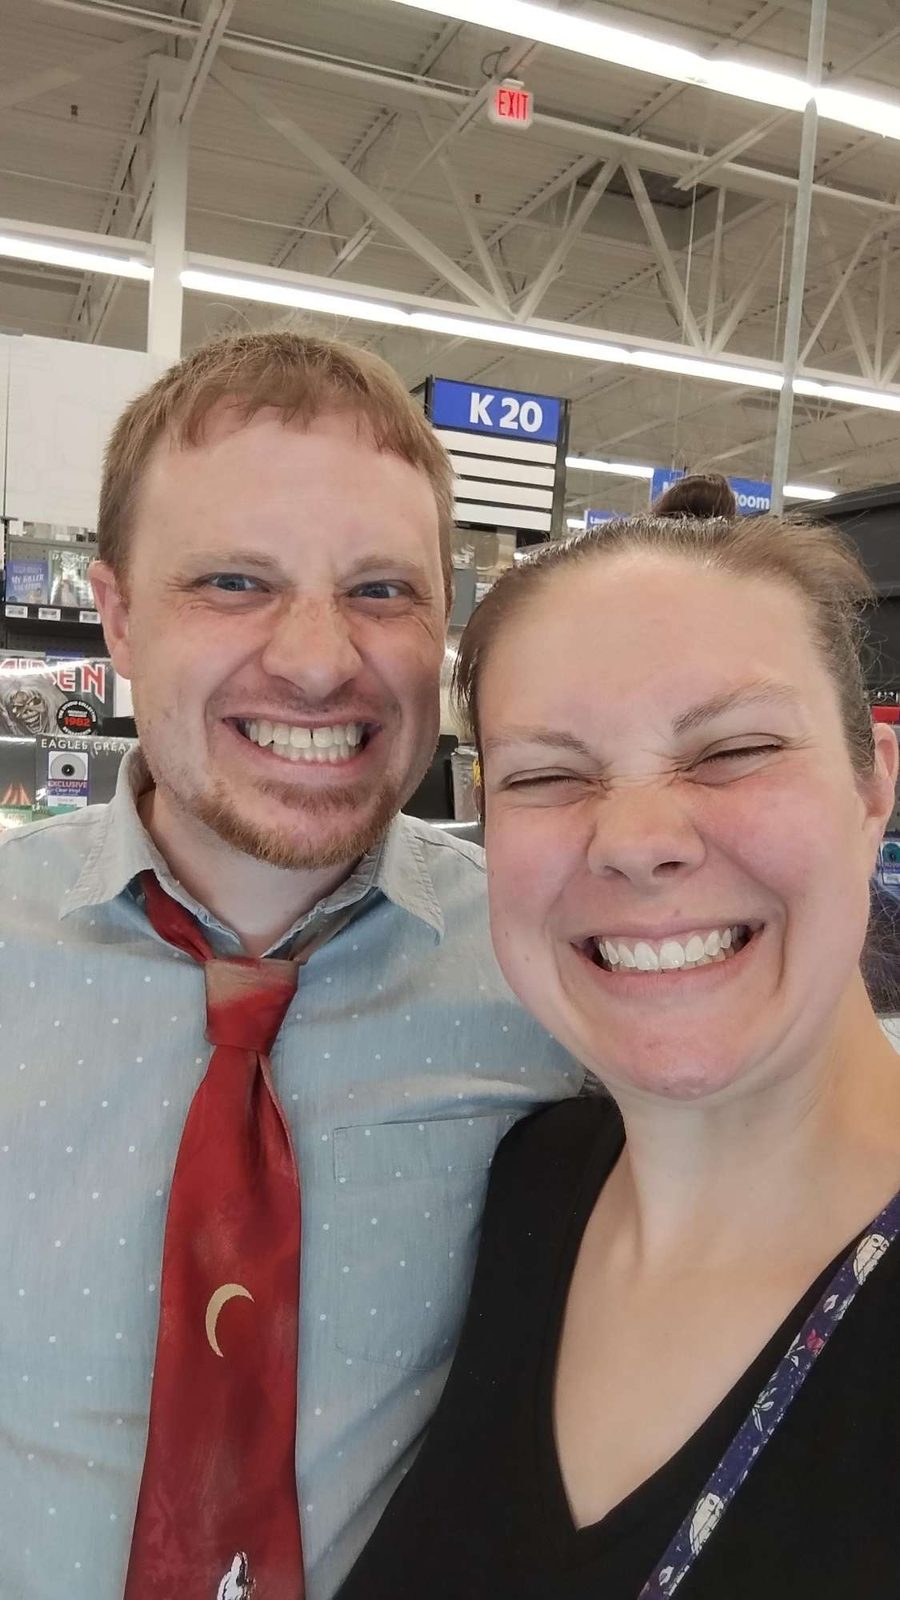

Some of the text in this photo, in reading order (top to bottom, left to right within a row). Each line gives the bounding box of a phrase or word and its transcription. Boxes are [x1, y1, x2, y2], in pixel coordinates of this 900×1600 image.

[499, 90, 528, 120] EXIT
[470, 392, 543, 433] K 20
[63, 717, 91, 727] 1982
[41, 738, 88, 750] EAGLES
[48, 780, 87, 789] EXCLUSIVE
